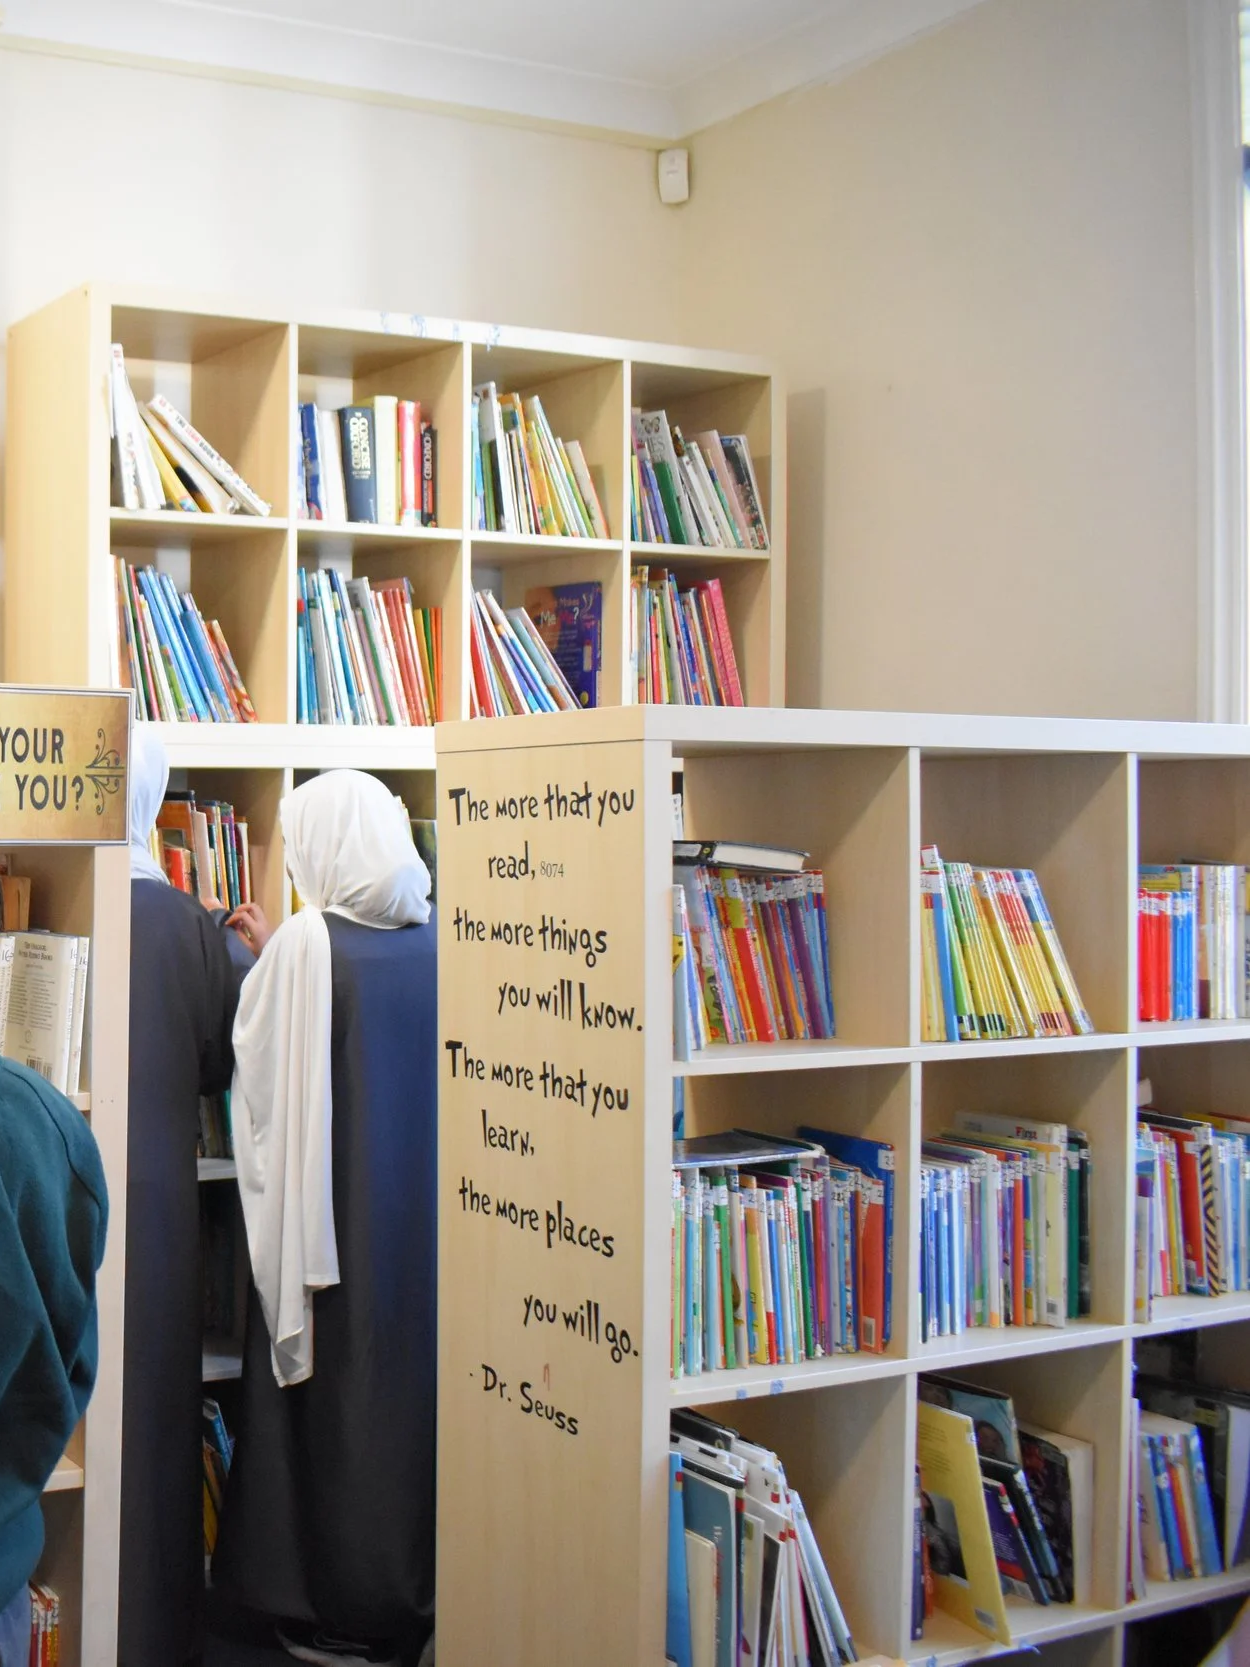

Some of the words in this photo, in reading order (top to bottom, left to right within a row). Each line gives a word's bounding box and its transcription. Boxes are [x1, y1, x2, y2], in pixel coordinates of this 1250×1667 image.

[349, 416, 362, 469] OXFORD
[359, 416, 372, 470] CONCISE
[422, 436, 434, 480] OXFORD
[14, 774, 84, 812] YOU?
[448, 787, 489, 826] The
[496, 795, 538, 820] more
[544, 781, 592, 822] that
[598, 789, 634, 828] you
[488, 840, 536, 880] read,
[540, 860, 564, 878] 8074
[2, 950, 14, 962] 16
[40, 953, 53, 961] BOOKS
[454, 906, 486, 942] the
[490, 920, 534, 947] more
[538, 914, 608, 968] things
[498, 982, 530, 1016] you
[536, 978, 572, 1021] will
[578, 982, 642, 1032] know.
[445, 1040, 486, 1081] The
[492, 1061, 534, 1091] more
[539, 1061, 587, 1107] that
[592, 1082, 628, 1118] you
[482, 1109, 534, 1156] learn,
[1015, 1126, 1038, 1141] First
[458, 1176, 491, 1216] the
[496, 1198, 539, 1232] more
[546, 1200, 615, 1258] places
[523, 1294, 556, 1328] you
[562, 1299, 600, 1345] will
[605, 1322, 639, 1364] go.
[482, 1364, 512, 1402] Dr.
[520, 1382, 578, 1436] Seuss
